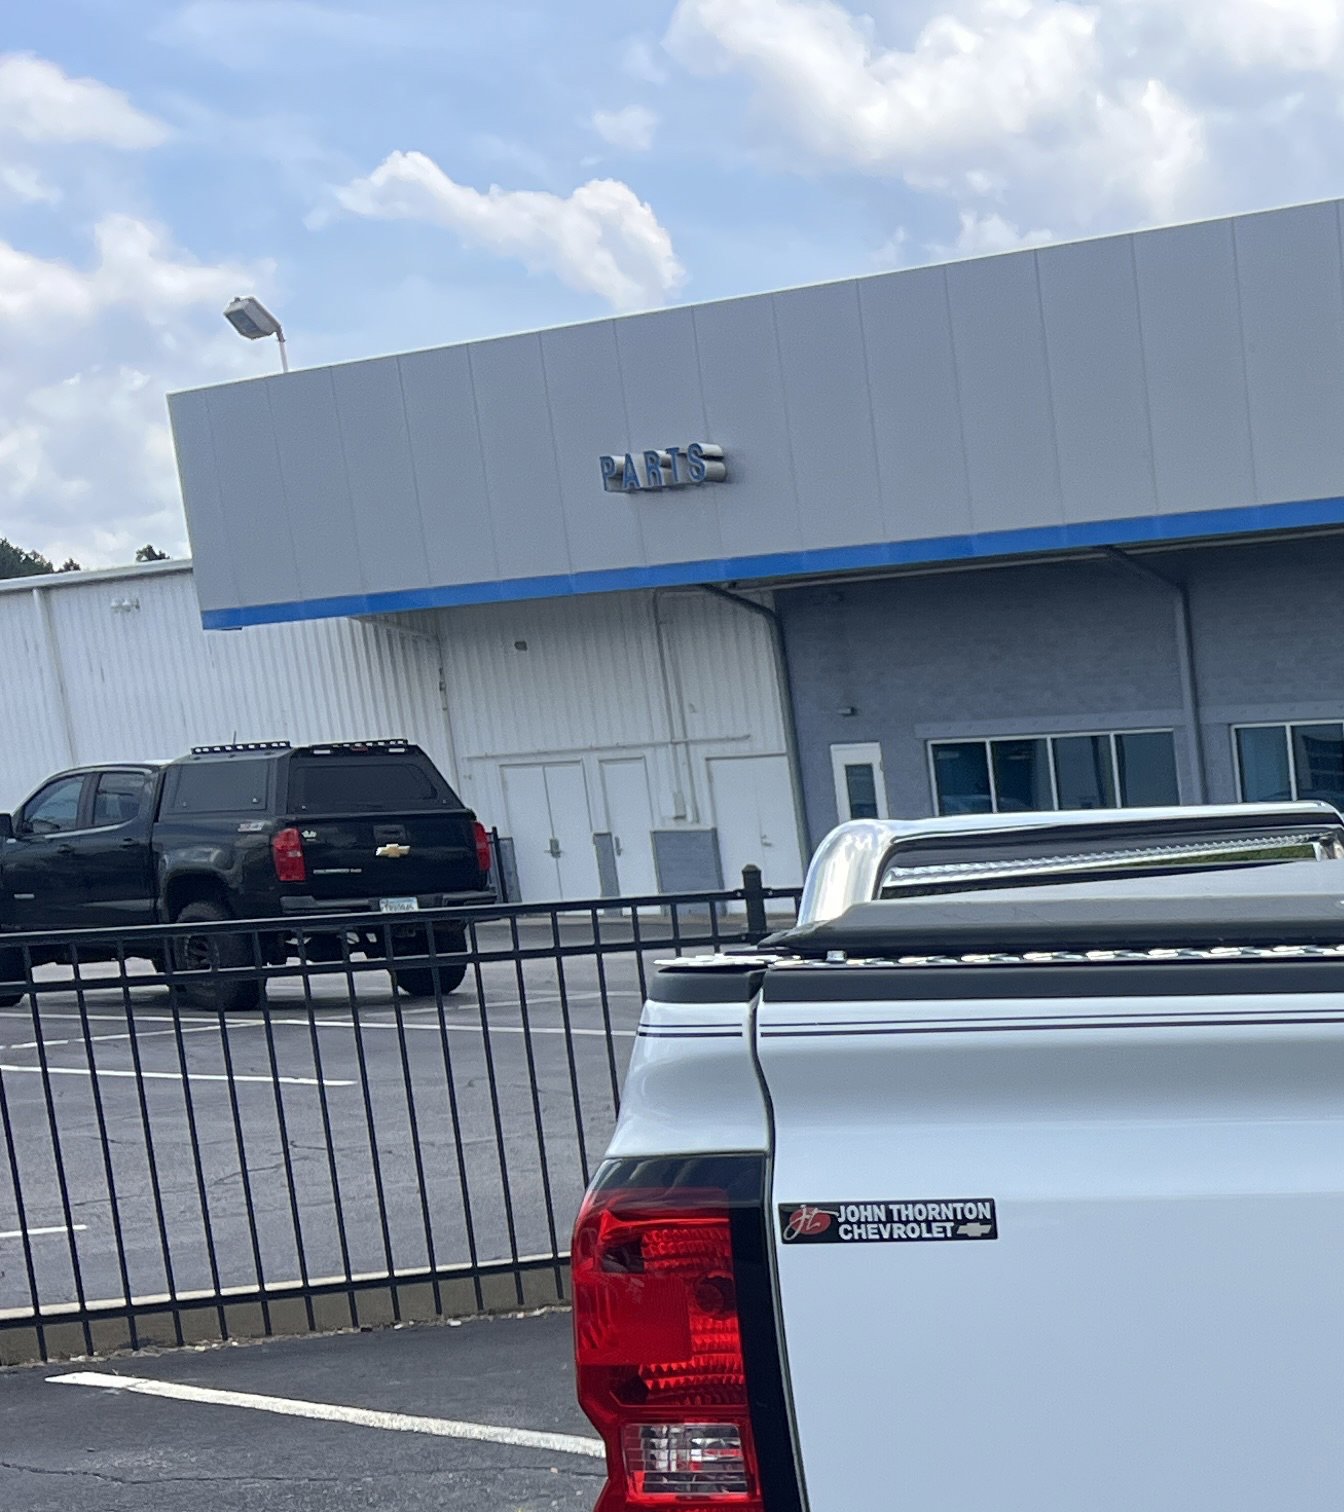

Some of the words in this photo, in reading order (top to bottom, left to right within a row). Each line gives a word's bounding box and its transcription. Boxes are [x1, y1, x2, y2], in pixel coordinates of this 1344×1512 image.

[600, 443, 712, 491] PARTS
[837, 1204, 886, 1223] JOHN
[889, 1202, 992, 1222] THORNTON
[838, 1222, 954, 1240] CHEVROLET
